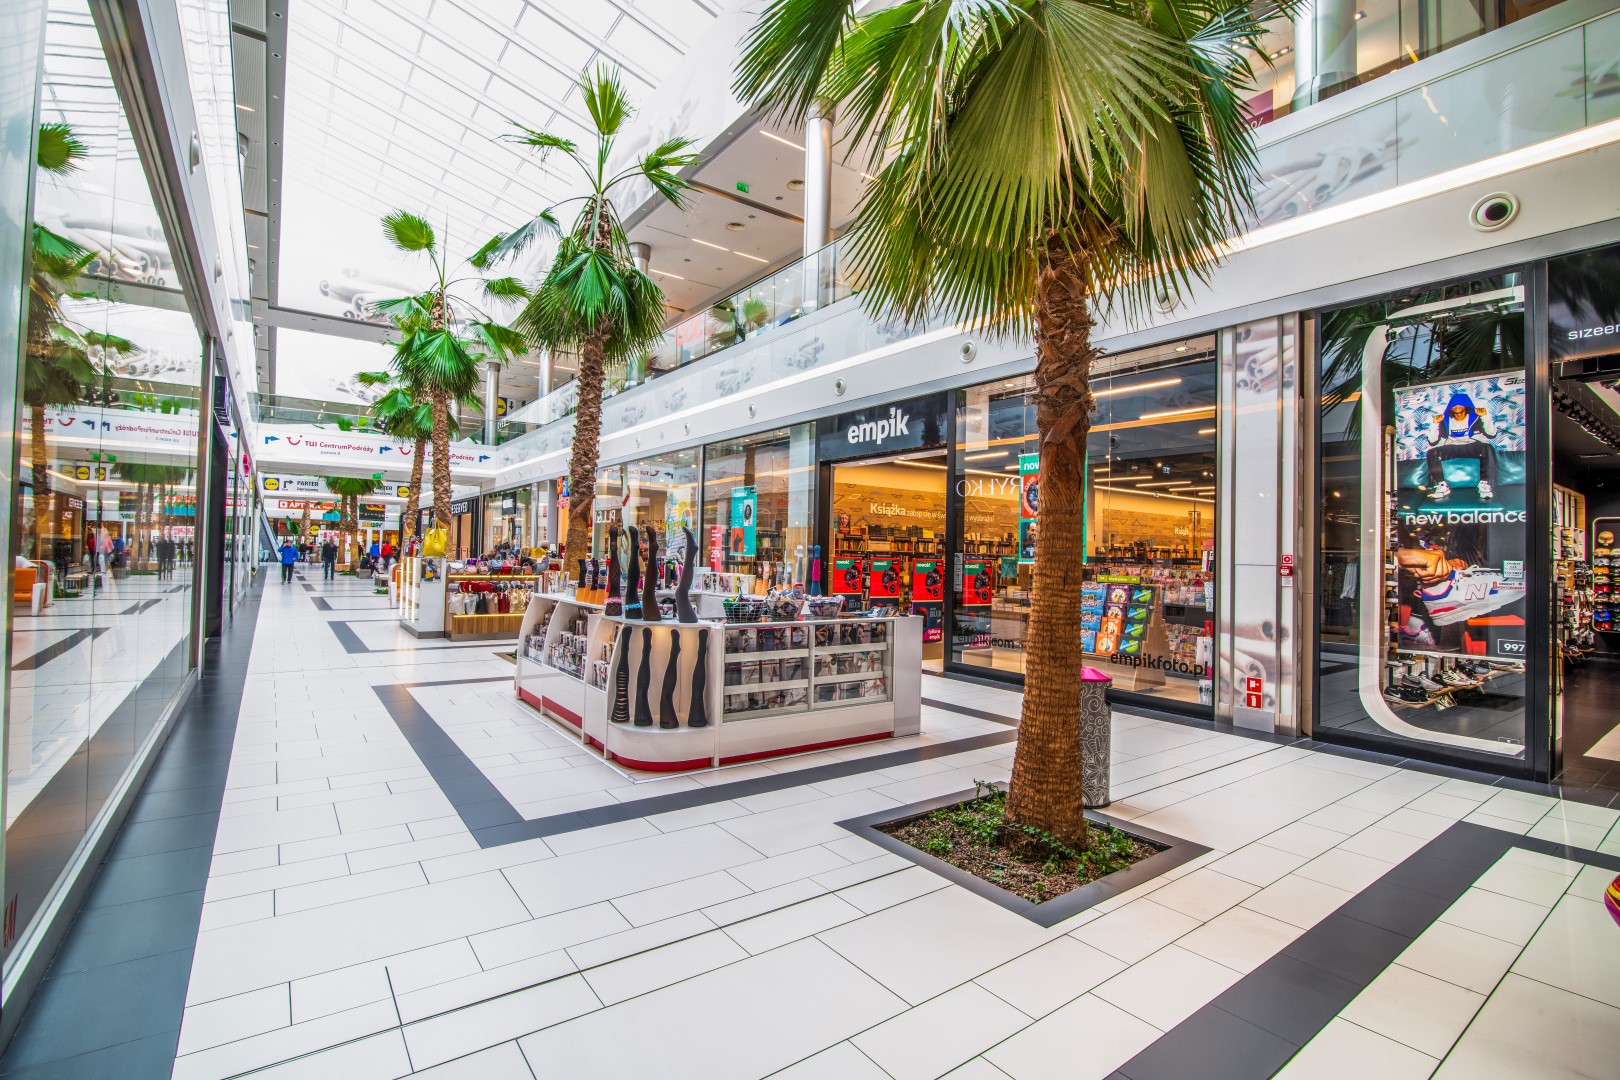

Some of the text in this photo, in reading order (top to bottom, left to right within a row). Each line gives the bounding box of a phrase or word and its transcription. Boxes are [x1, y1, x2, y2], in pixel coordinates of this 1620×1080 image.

[847, 407, 910, 444] empik
[319, 441, 374, 454] CentrumPodróży
[451, 501, 468, 515] ESERVED
[869, 503, 906, 517] Książka
[1405, 510, 1526, 526] new balance
[1503, 642, 1526, 652] 997
[1110, 653, 1209, 678] empikfoto.pl
